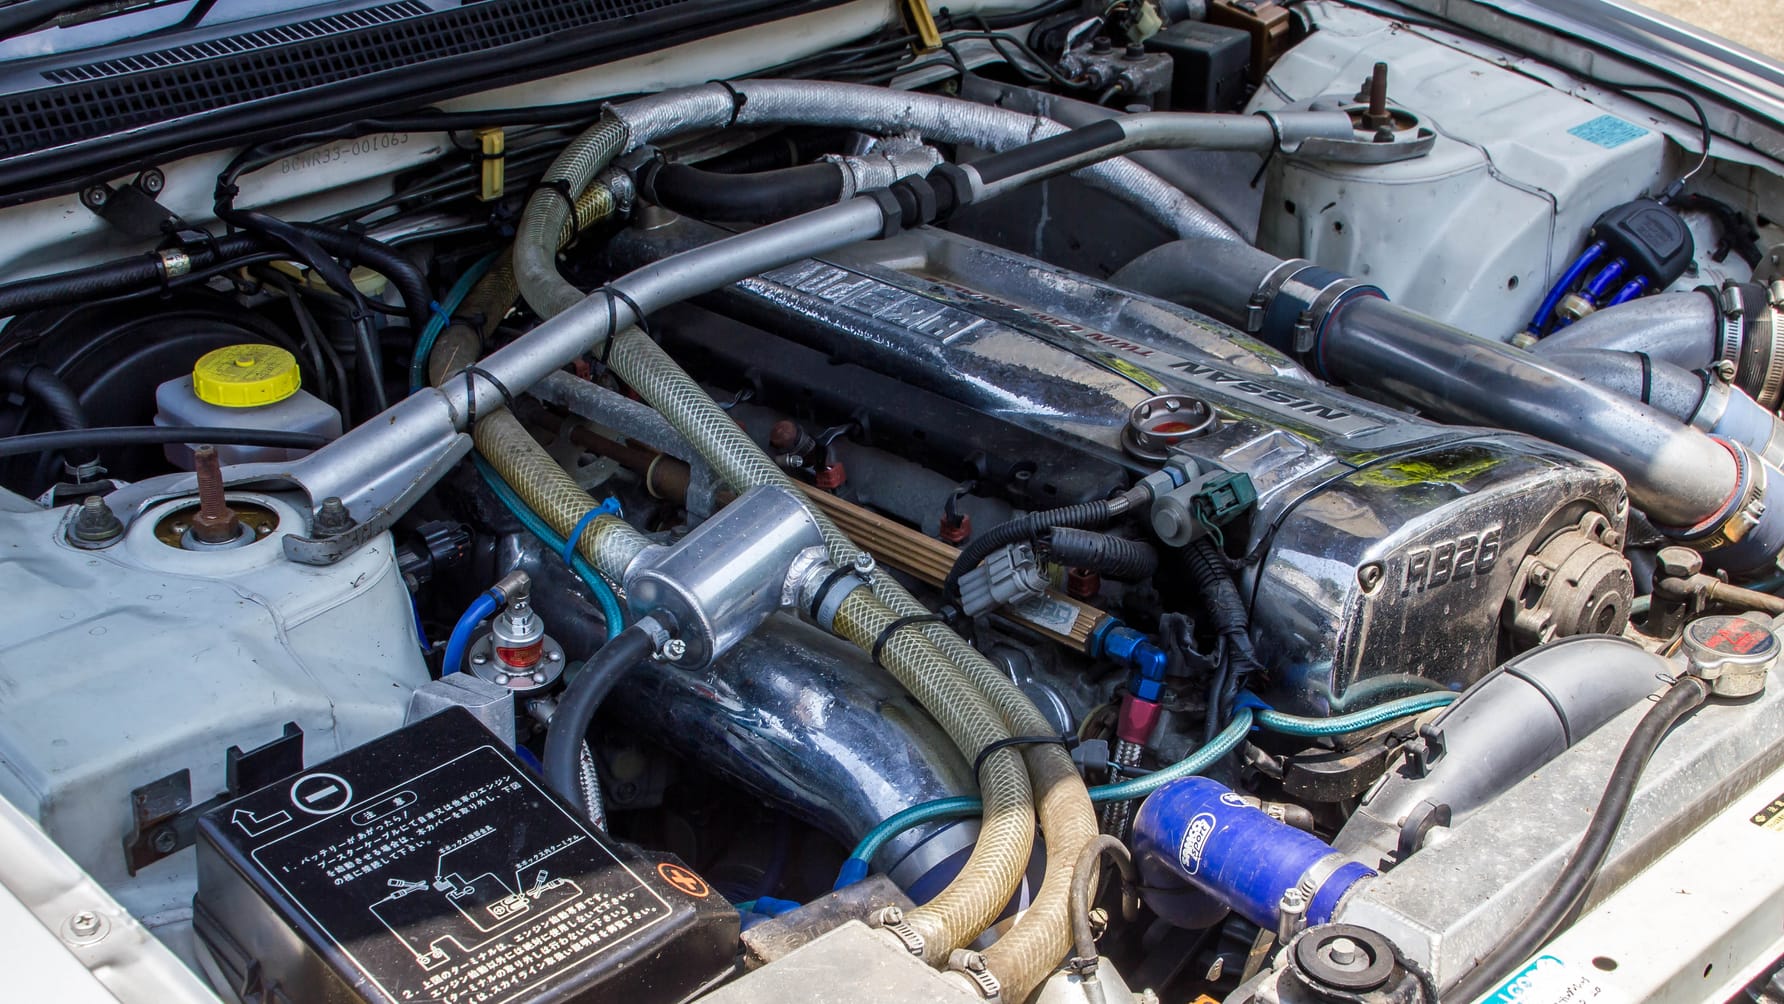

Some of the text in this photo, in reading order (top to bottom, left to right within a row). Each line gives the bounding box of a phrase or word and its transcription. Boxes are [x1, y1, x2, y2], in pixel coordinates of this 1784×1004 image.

[1085, 333, 1154, 358] TWIN
[1168, 361, 1352, 422] NISSAN
[1400, 524, 1502, 598] RB26
